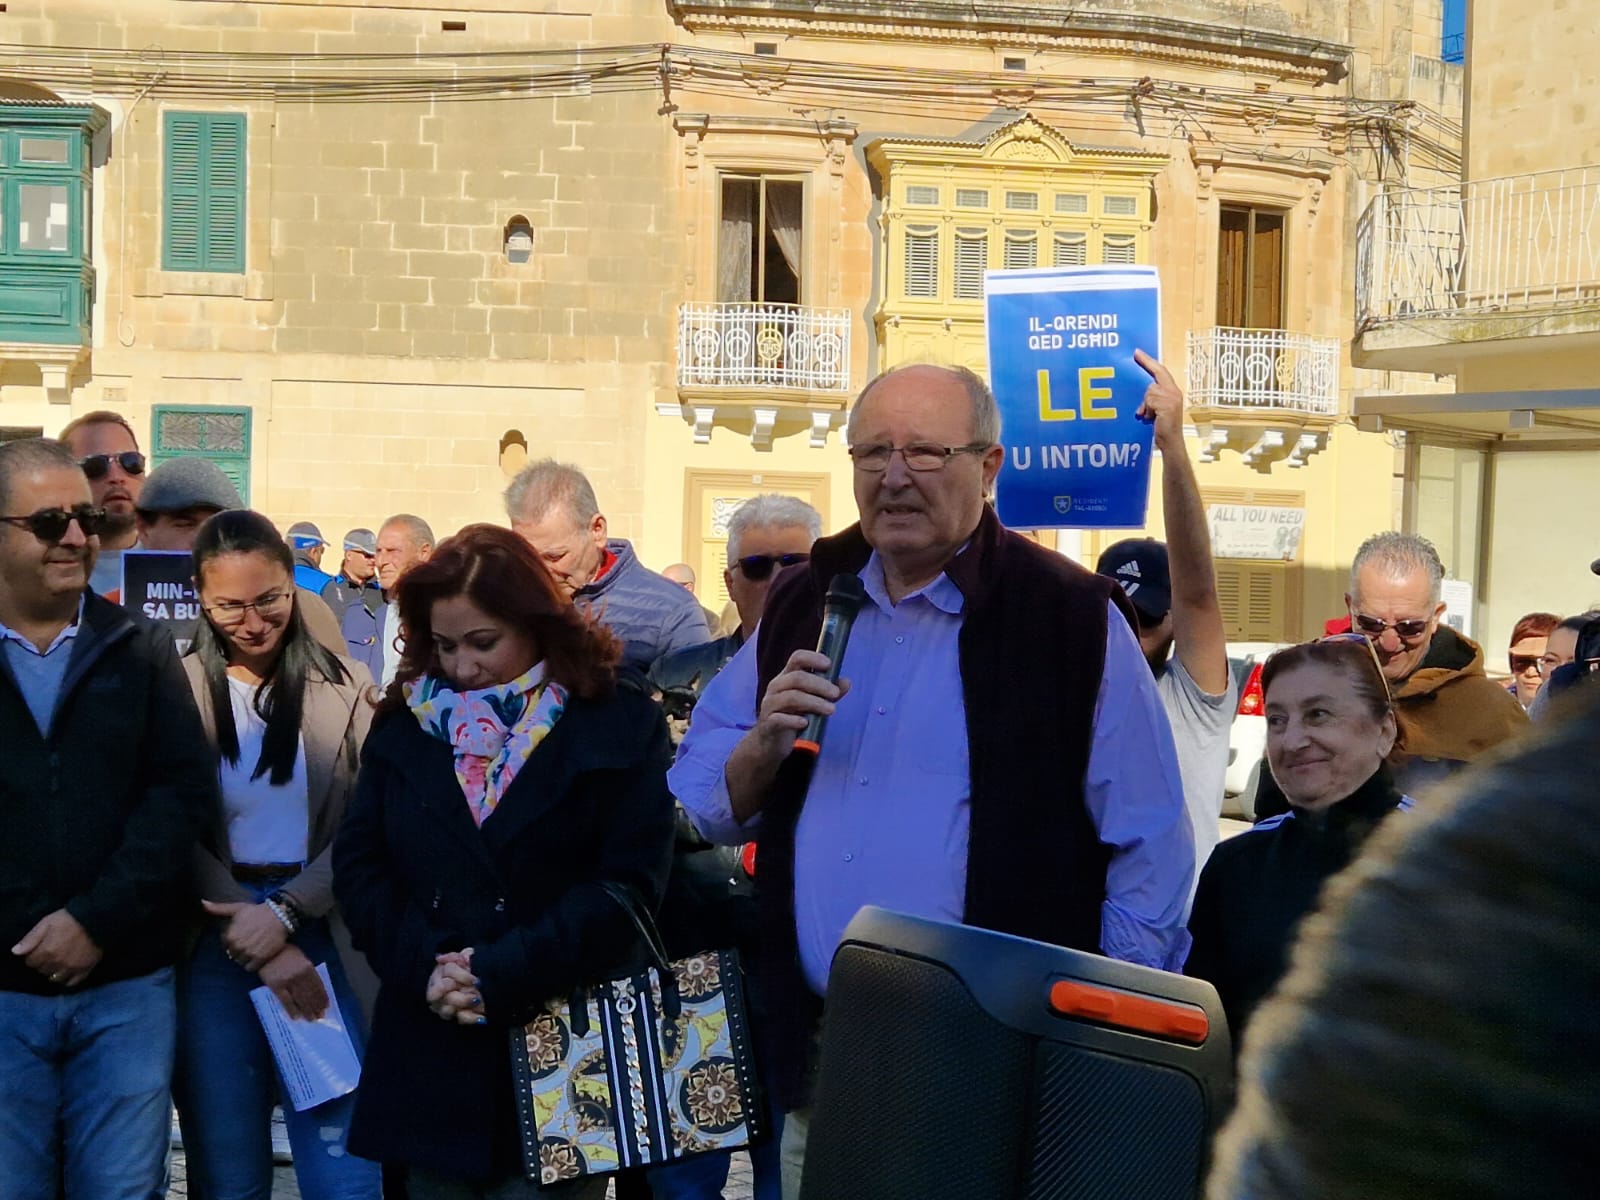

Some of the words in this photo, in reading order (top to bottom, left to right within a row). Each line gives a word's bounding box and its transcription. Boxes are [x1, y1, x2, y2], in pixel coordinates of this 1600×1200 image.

[1029, 314, 1118, 332] IL-QRENDI
[1028, 334, 1062, 350] QED
[1067, 332, 1119, 349] JGĦID
[1037, 367, 1118, 422] LE
[1012, 446, 1031, 470] U
[1042, 443, 1141, 470] INTOM?
[1213, 507, 1237, 521] ALL
[1241, 508, 1267, 522] YOU
[1269, 510, 1303, 525] NEED
[142, 602, 170, 620] SA
